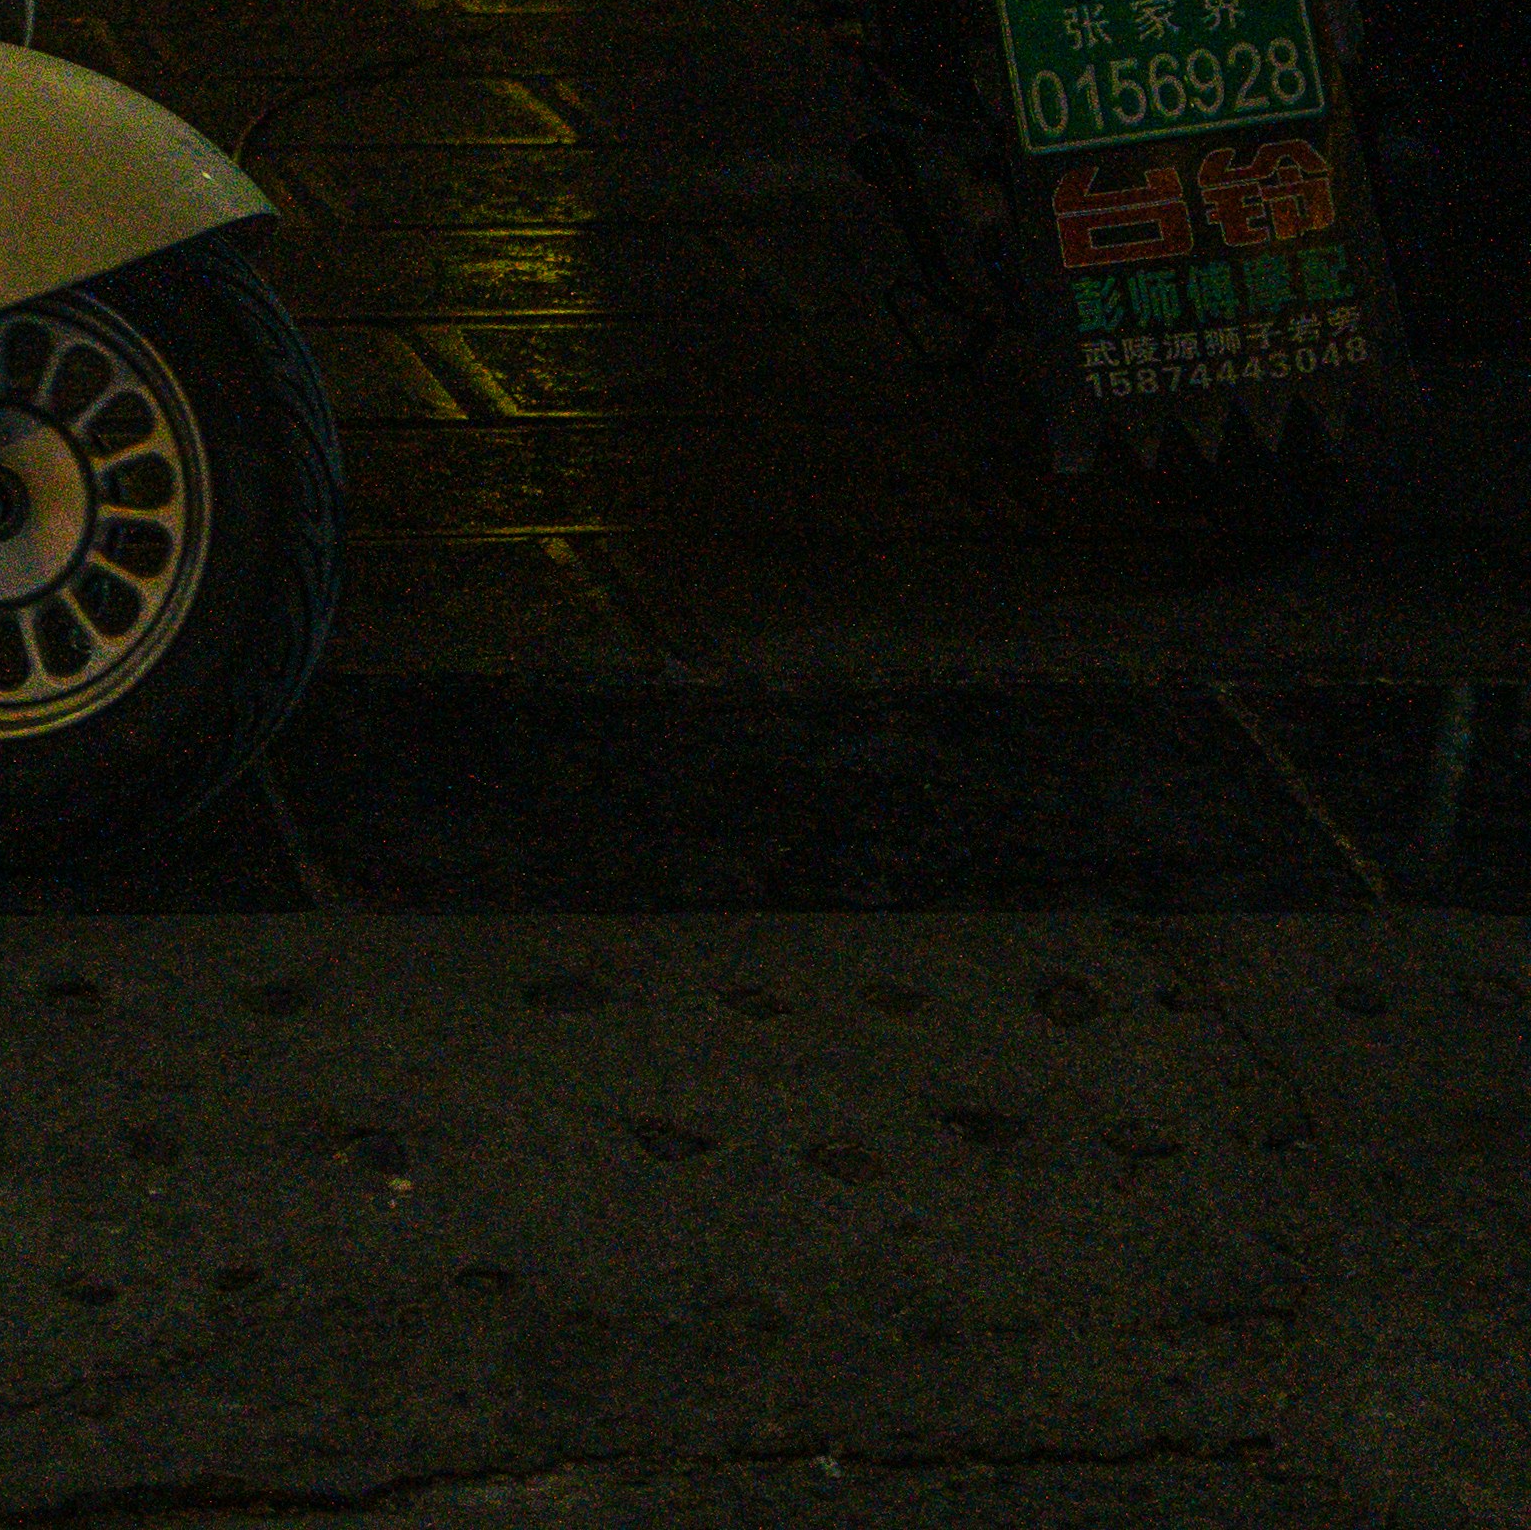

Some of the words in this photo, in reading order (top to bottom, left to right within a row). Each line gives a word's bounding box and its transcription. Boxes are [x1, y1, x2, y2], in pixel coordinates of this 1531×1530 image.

[1030, 36, 1308, 136] 0156928
[1051, 138, 1336, 268] 台铃
[1084, 335, 1369, 399] 15874443048
